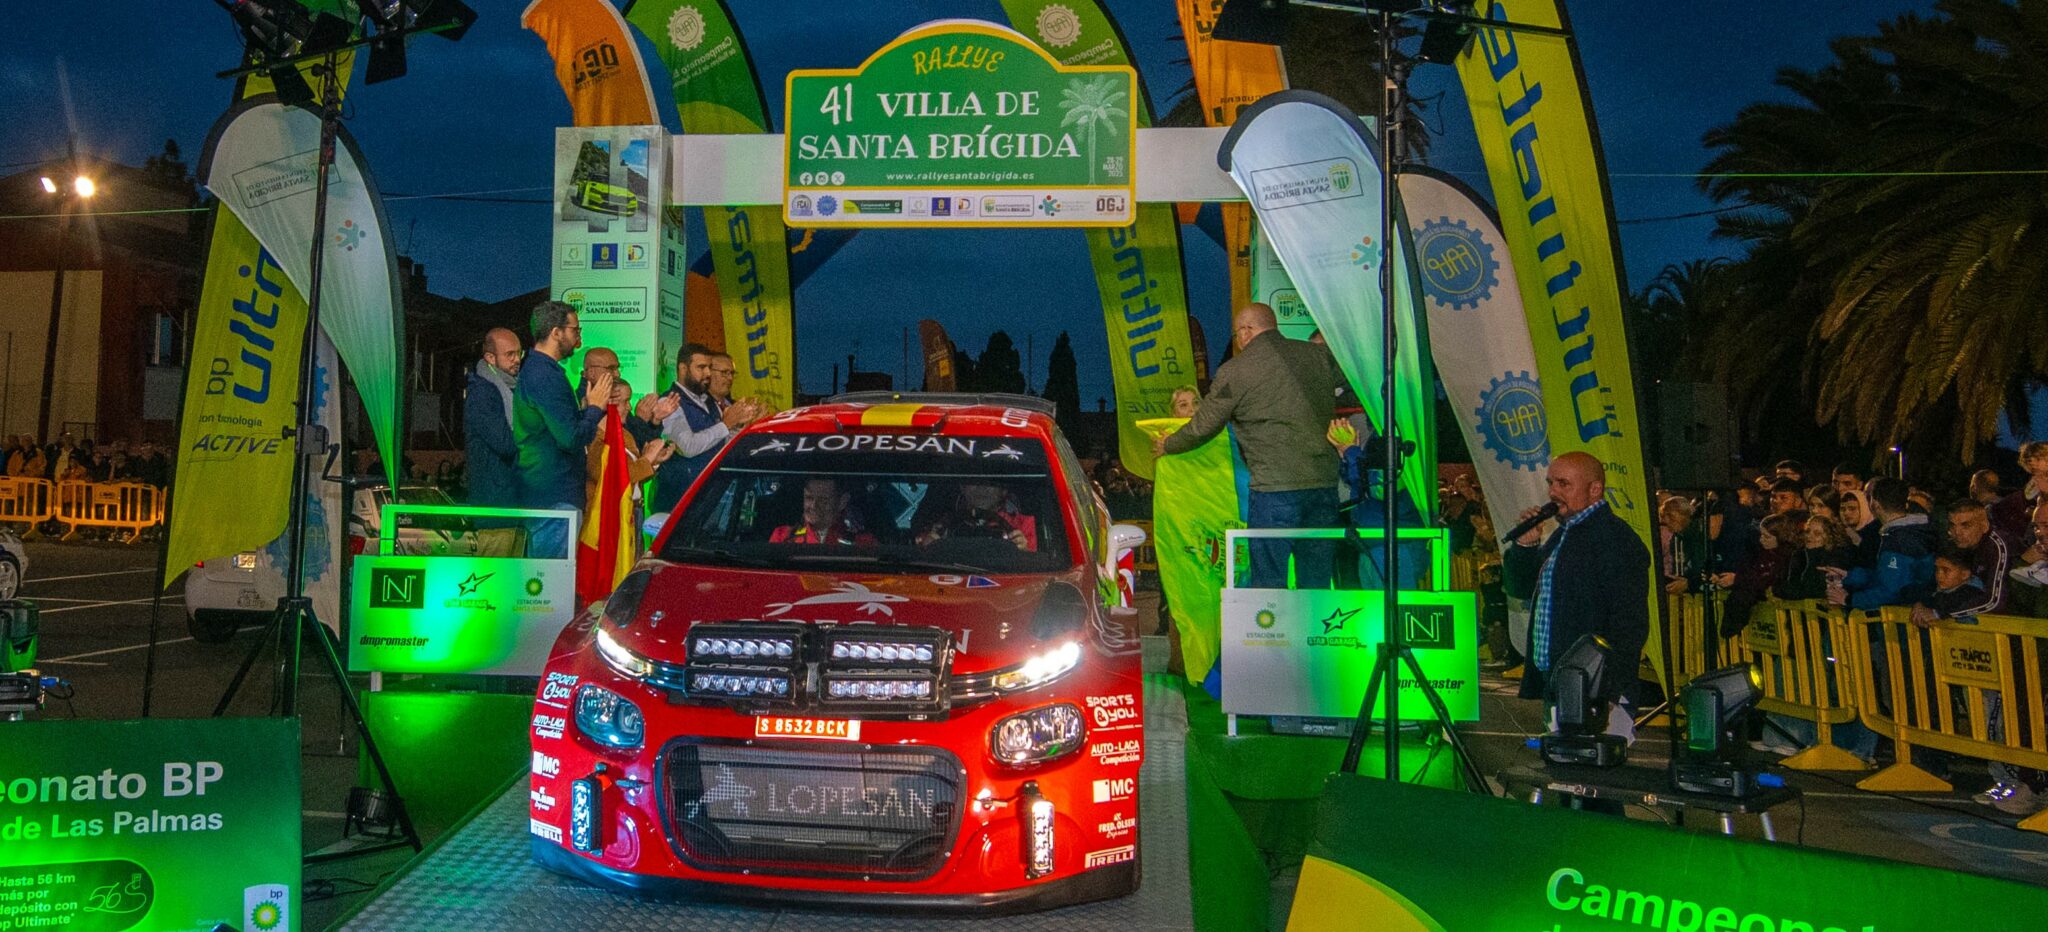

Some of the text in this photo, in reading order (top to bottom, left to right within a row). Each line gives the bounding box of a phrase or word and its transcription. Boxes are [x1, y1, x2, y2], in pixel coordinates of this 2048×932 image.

[913, 46, 1004, 75] RALLYE
[820, 83, 1040, 125] 41 VILLA DE
[798, 125, 1081, 160] SANTA BRÍGIDA
[886, 170, 1035, 182] www.rallyesantabrigida.es
[585, 306, 609, 314] SANTA
[192, 433, 282, 455] ACTIVE
[795, 434, 976, 456] LOPESAN
[1085, 693, 1135, 708] SPORTS
[760, 719, 845, 736] S 8532 BCK
[542, 755, 560, 775] MC
[0, 761, 224, 805] onato BP
[1111, 777, 1134, 797] MC
[767, 783, 935, 818] LOPESAN
[2, 809, 224, 841] de Las Palmas
[1084, 843, 1135, 869] PIRELLI
[0, 873, 76, 887] Hasta 56 km
[27, 889, 50, 902] por
[269, 889, 283, 900] bp
[54, 902, 78, 911] con
